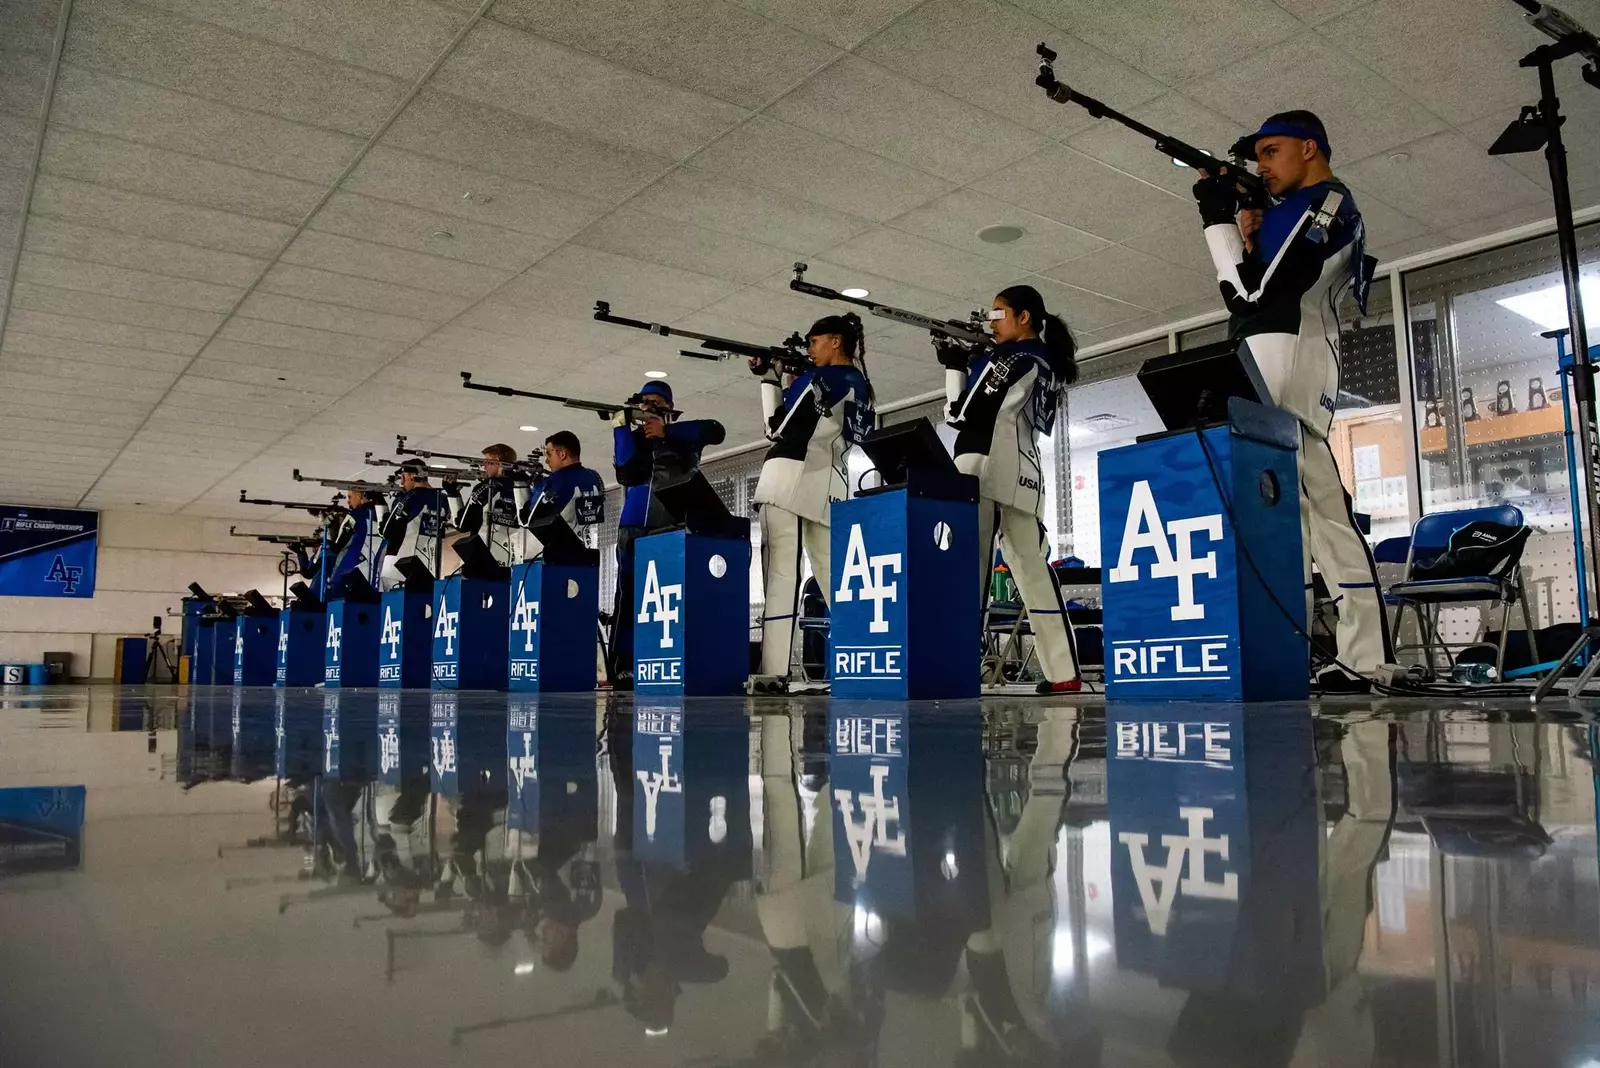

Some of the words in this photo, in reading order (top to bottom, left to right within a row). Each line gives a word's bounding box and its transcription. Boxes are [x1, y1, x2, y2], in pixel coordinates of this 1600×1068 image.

[1320, 393, 1335, 414] USA
[1019, 476, 1039, 492] USA
[15, 521, 33, 529] RIFLE
[33, 522, 84, 531] CHAMPIONSHIPS
[1109, 480, 1223, 621] AF
[44, 554, 83, 593] AF
[835, 523, 902, 633] AF
[512, 580, 539, 652] AF
[637, 560, 682, 649] AF
[381, 605, 402, 659] AF
[434, 594, 459, 655] AF
[326, 613, 342, 661] AF
[511, 662, 537, 678] RIFLE
[835, 651, 900, 674] RIFLE
[1113, 642, 1228, 675] RIFLE
[9, 668, 20, 682] S
[326, 668, 340, 679] RIFLE
[380, 666, 400, 678] RIFLE
[433, 664, 457, 678] RIFLE
[638, 662, 681, 680] RIFLE
